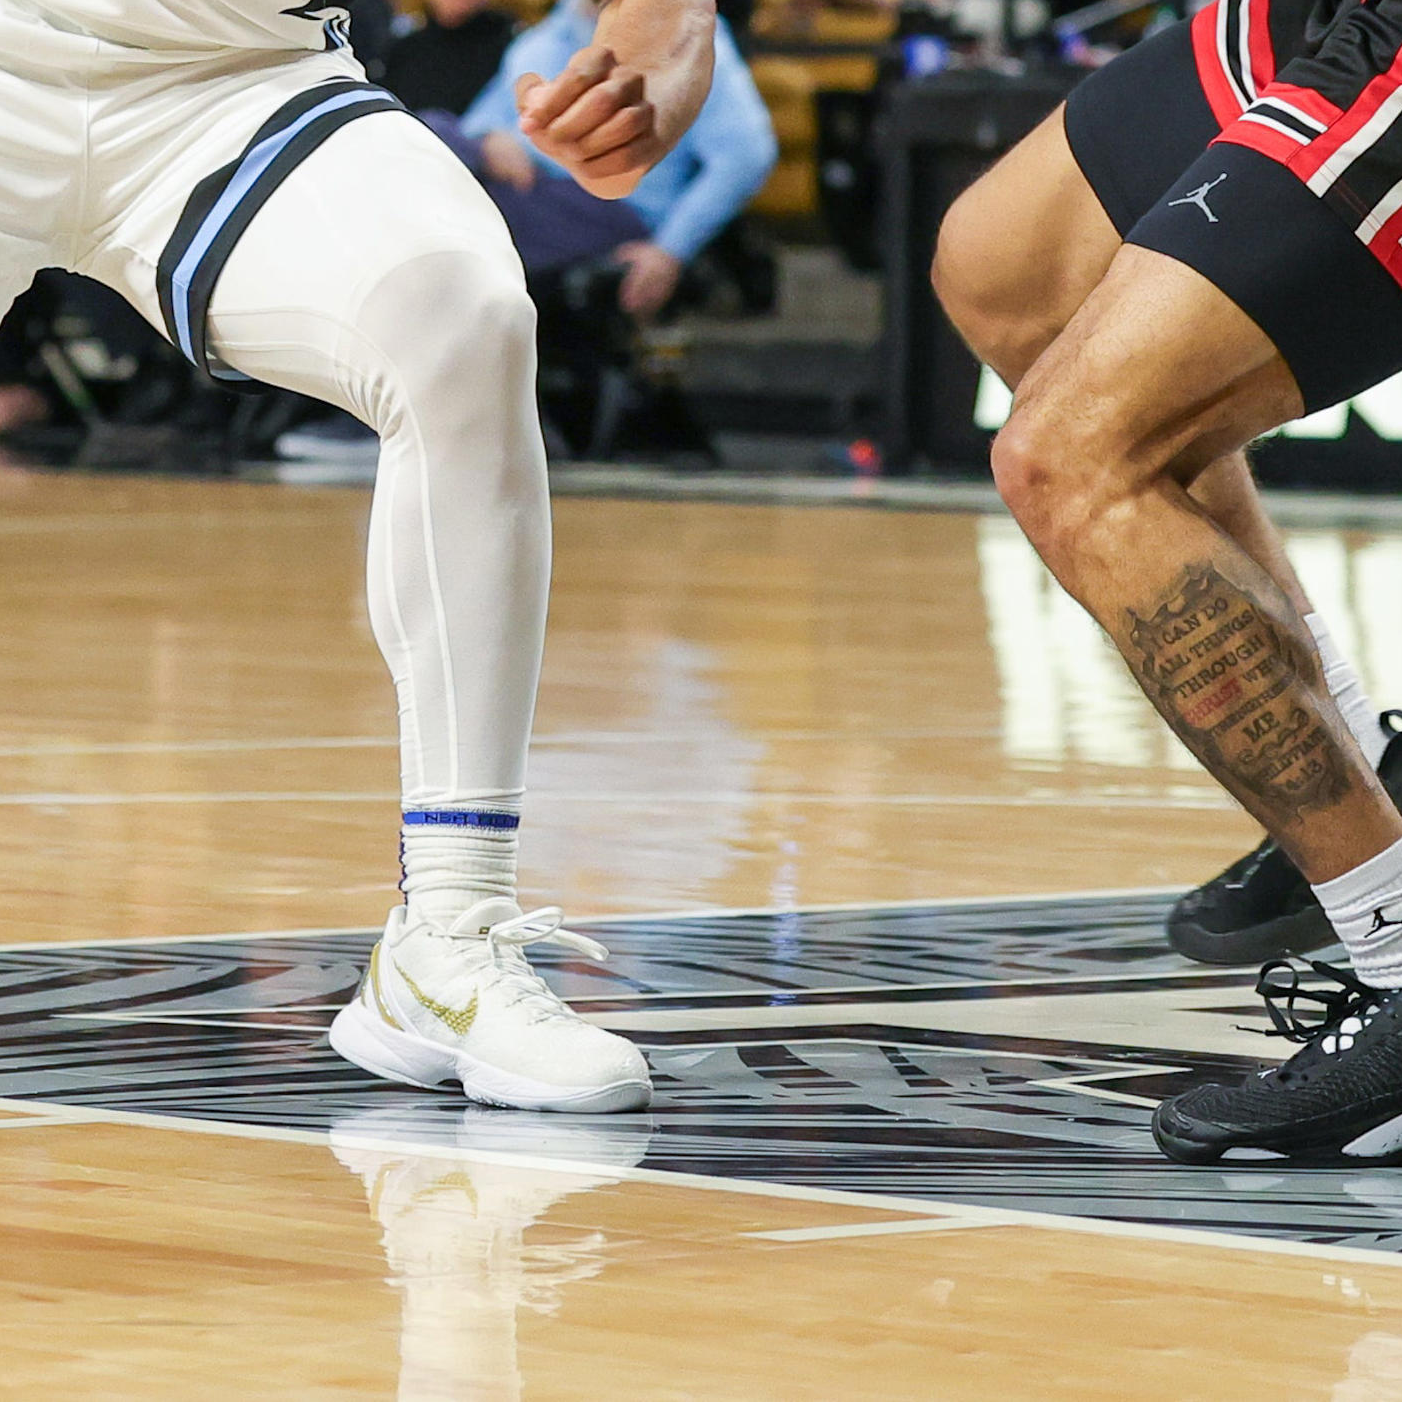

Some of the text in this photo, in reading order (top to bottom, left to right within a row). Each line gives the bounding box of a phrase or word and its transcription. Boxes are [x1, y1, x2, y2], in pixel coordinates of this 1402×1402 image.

[1159, 608, 1255, 676] ALL THINGS
[1162, 613, 1201, 645] CAN
[1201, 597, 1229, 621] DO
[1175, 634, 1266, 698] THROUGH
[1182, 677, 1244, 726] CHRIST
[1242, 710, 1280, 744] ME
